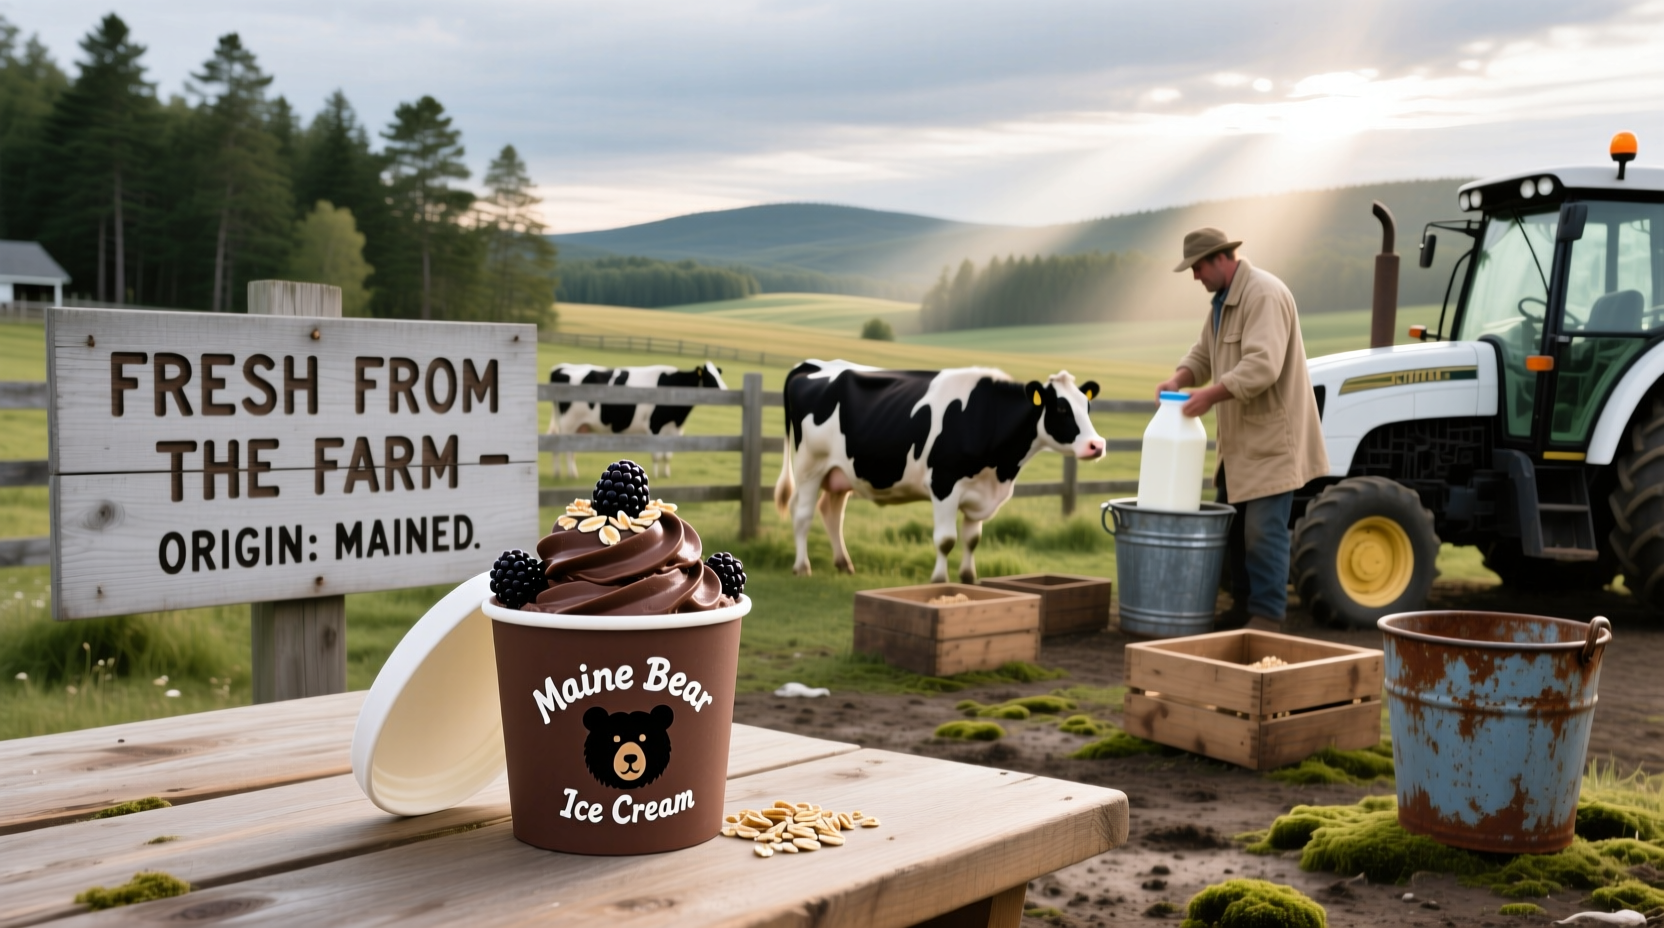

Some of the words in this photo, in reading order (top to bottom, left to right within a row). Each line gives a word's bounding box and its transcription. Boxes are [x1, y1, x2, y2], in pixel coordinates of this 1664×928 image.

[110, 351, 319, 418] FRESH
[354, 356, 499, 415] FROM
[155, 438, 280, 502] THE
[314, 434, 459, 495] FARM
[158, 524, 319, 574] ORIGIN:
[334, 514, 481, 561] MAINED.
[532, 663, 634, 725] Maine
[643, 656, 713, 712] Bear
[559, 787, 604, 823] Ice
[611, 789, 695, 825] Cream
